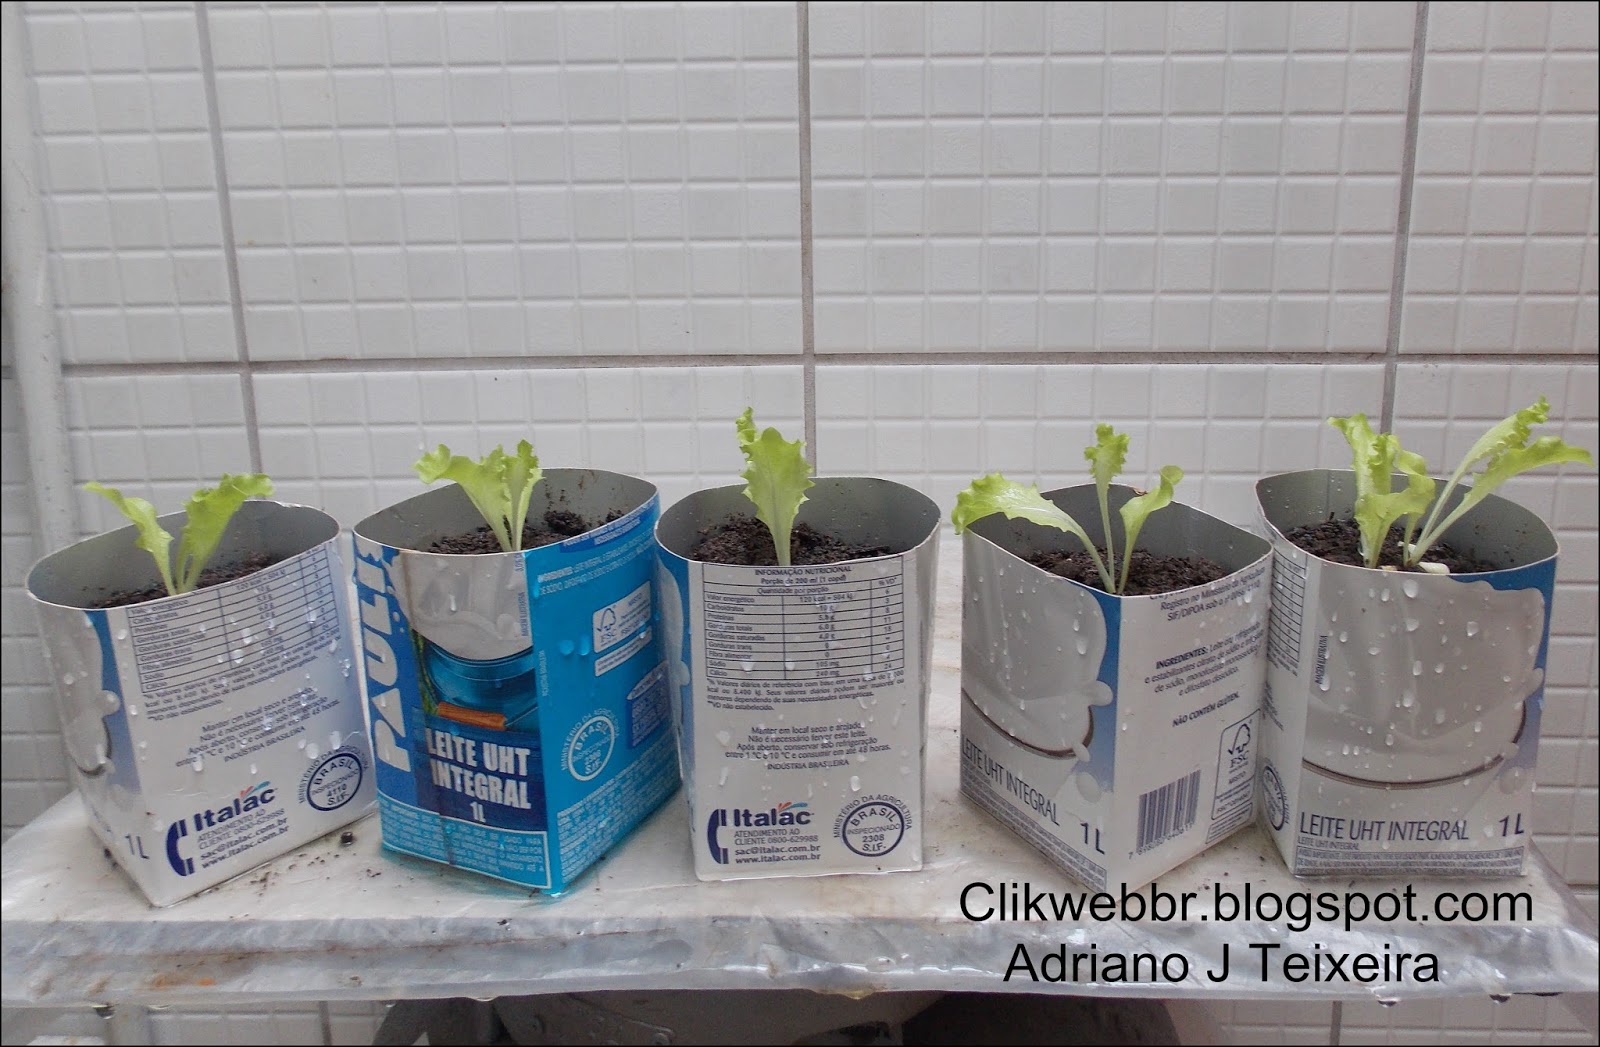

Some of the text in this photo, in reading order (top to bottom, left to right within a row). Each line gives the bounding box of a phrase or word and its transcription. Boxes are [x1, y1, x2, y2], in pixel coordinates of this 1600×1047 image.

[755, 566, 852, 577] INFORMAÇÃO NUTRICIONAL
[757, 587, 794, 595] Quantidade
[1160, 596, 1190, 611] Registro
[1191, 594, 1200, 603] no
[1206, 600, 1218, 610] sob
[708, 632, 735, 640] Gorduras
[708, 641, 735, 650] Gorduras
[1151, 662, 1196, 683] estabilizantes
[1154, 684, 1165, 693] de
[1172, 715, 1188, 727] NÃO
[1189, 702, 1216, 721] CONTÉM
[575, 721, 609, 751] BRASIL
[751, 727, 777, 735] Manter
[792, 726, 809, 734] local
[425, 727, 531, 776] LEITE UHT
[725, 751, 744, 759] entre
[769, 751, 779, 759] 10
[798, 750, 831, 759] consumir
[859, 745, 868, 753] 48
[737, 743, 755, 752] Após
[784, 743, 819, 751] conservar
[821, 741, 835, 749] sob
[767, 761, 806, 770] INDÚSTRIA
[1230, 750, 1250, 768] FSC
[313, 758, 353, 785] BRASIL
[429, 758, 532, 809] INTEGRAL
[962, 734, 1061, 827] LEITE UHT INTEGRAL
[193, 788, 276, 832] Italac
[470, 801, 487, 823] 1L
[733, 808, 812, 827] Italac
[833, 799, 861, 838] MINISTÉRIO
[861, 795, 875, 803] DA
[850, 807, 897, 827] BRASIL
[198, 808, 266, 841] ATENDIMENTO AO
[734, 828, 800, 838] ATENDIMENTO AO
[847, 823, 901, 835] INSPECIONADO
[1300, 812, 1469, 841] LEITE UHT INTEGRAL
[199, 831, 232, 849] CLIENTE
[200, 817, 288, 860] sac@italac.com.br
[202, 825, 290, 868] www.italac.com.br
[734, 835, 819, 846] CLIENTE 0800-629988
[862, 834, 885, 843] 2308
[1298, 836, 1361, 851] LEITE UHT INTEGRAL
[735, 844, 821, 856] sac@italac.com.br
[735, 853, 821, 864] www.italac.com.br
